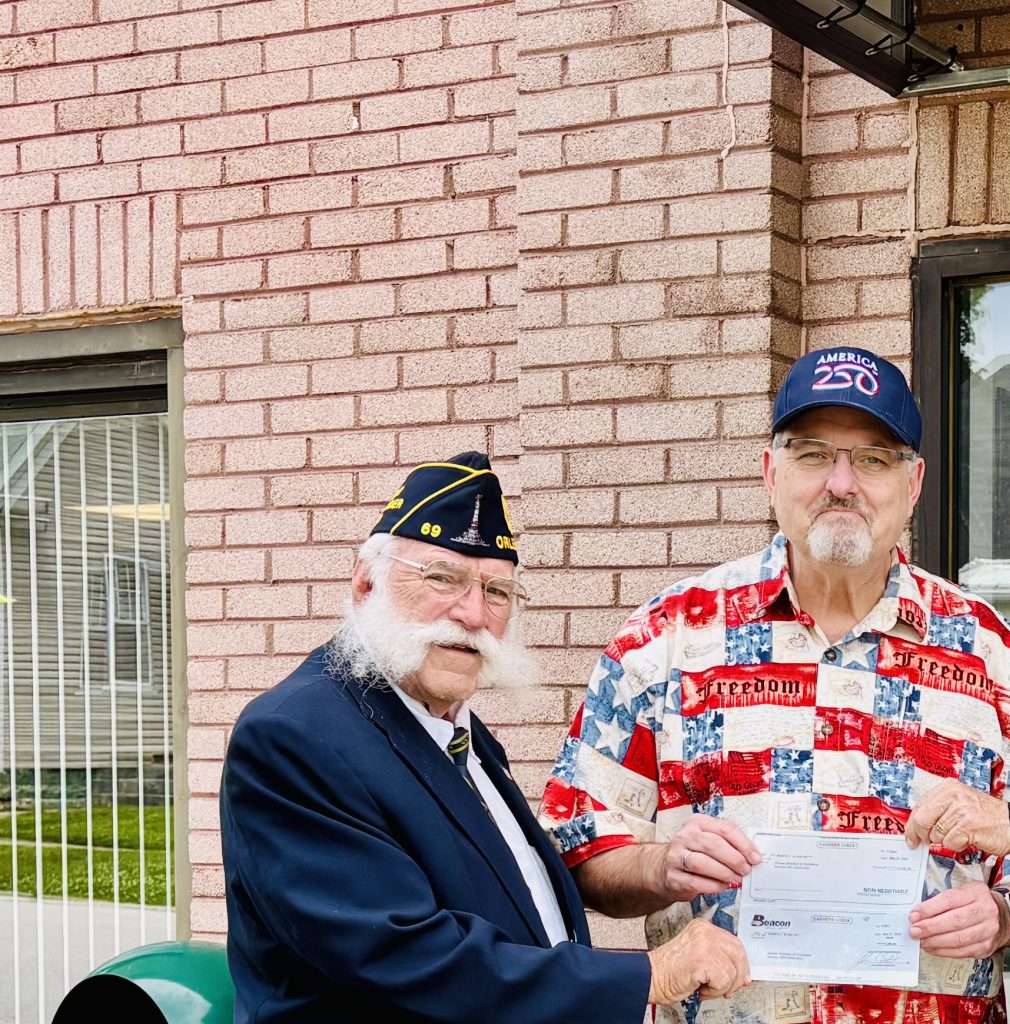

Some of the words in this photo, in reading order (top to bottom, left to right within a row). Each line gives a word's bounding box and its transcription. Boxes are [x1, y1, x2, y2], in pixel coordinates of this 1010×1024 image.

[817, 352, 878, 372] AMERICA
[812, 363, 880, 396] 250
[420, 522, 442, 538] 69
[496, 535, 517, 551] ORLE
[893, 651, 993, 691] Freedom
[697, 677, 800, 703] Freedom
[838, 811, 905, 833] Freed
[751, 914, 791, 927] Beacon
